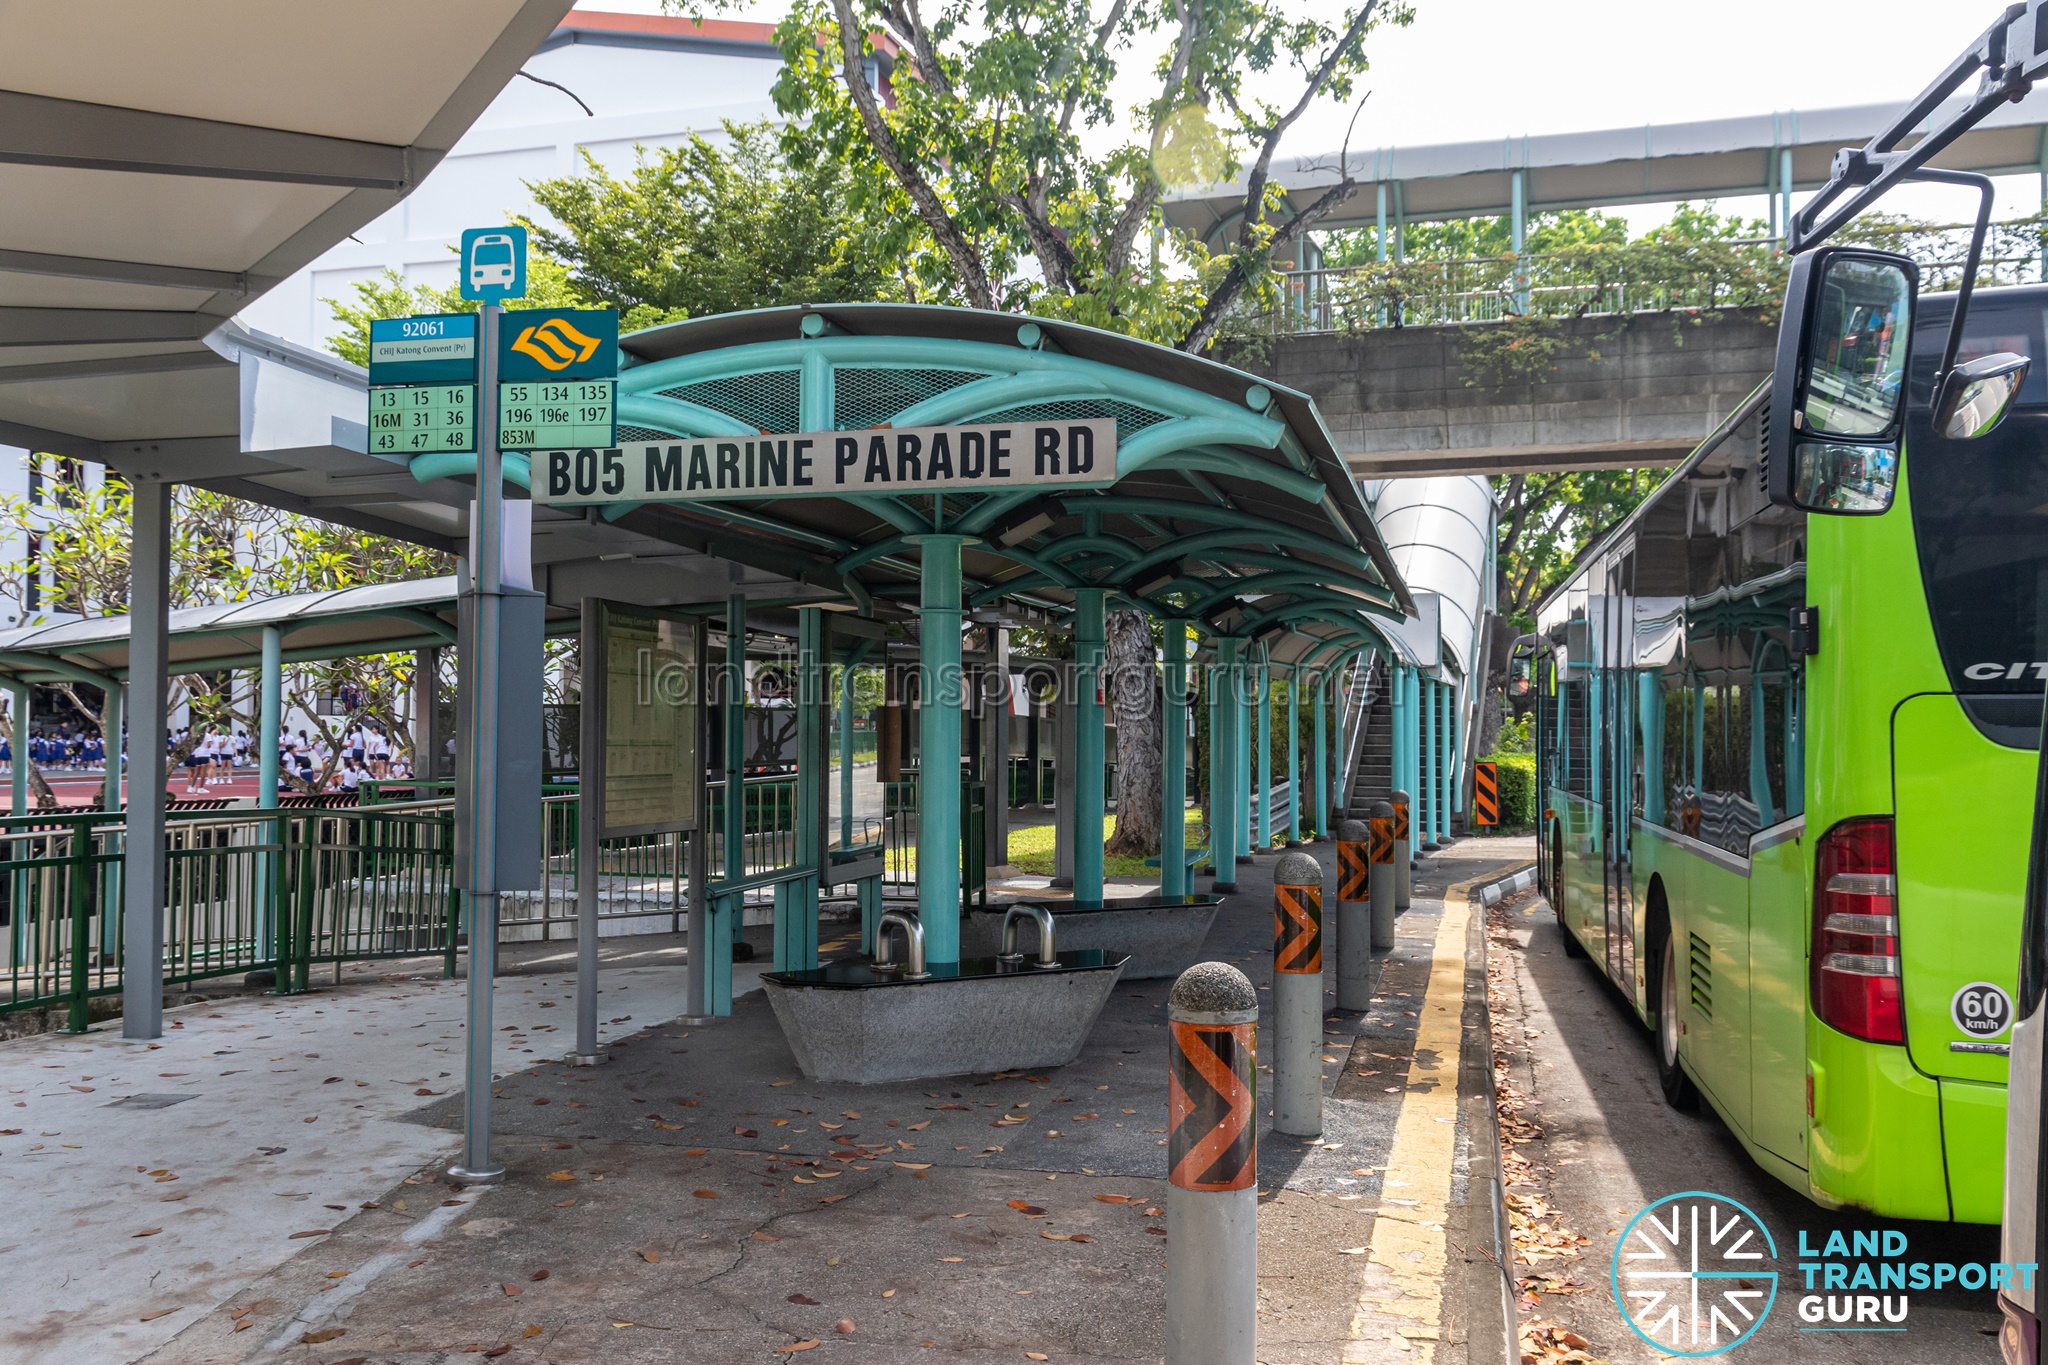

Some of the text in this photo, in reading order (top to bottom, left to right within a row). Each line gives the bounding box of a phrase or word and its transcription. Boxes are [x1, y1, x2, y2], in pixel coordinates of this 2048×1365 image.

[402, 320, 445, 337] 92061
[379, 343, 467, 356] CHIJ Katong Convent (Pr)
[379, 389, 464, 407] 13 15 16
[509, 385, 607, 402] 55 134 135
[373, 410, 464, 428] 16M 31 36
[505, 407, 607, 423] 196 196e 197
[377, 431, 464, 449] 43 47 48
[502, 429, 535, 444] 853M
[645, 439, 814, 493] MARINE
[835, 428, 1011, 483] PARADE
[1035, 425, 1095, 476] RD
[1962, 991, 2003, 1019] 60
[1965, 1018, 1999, 1030] km/h
